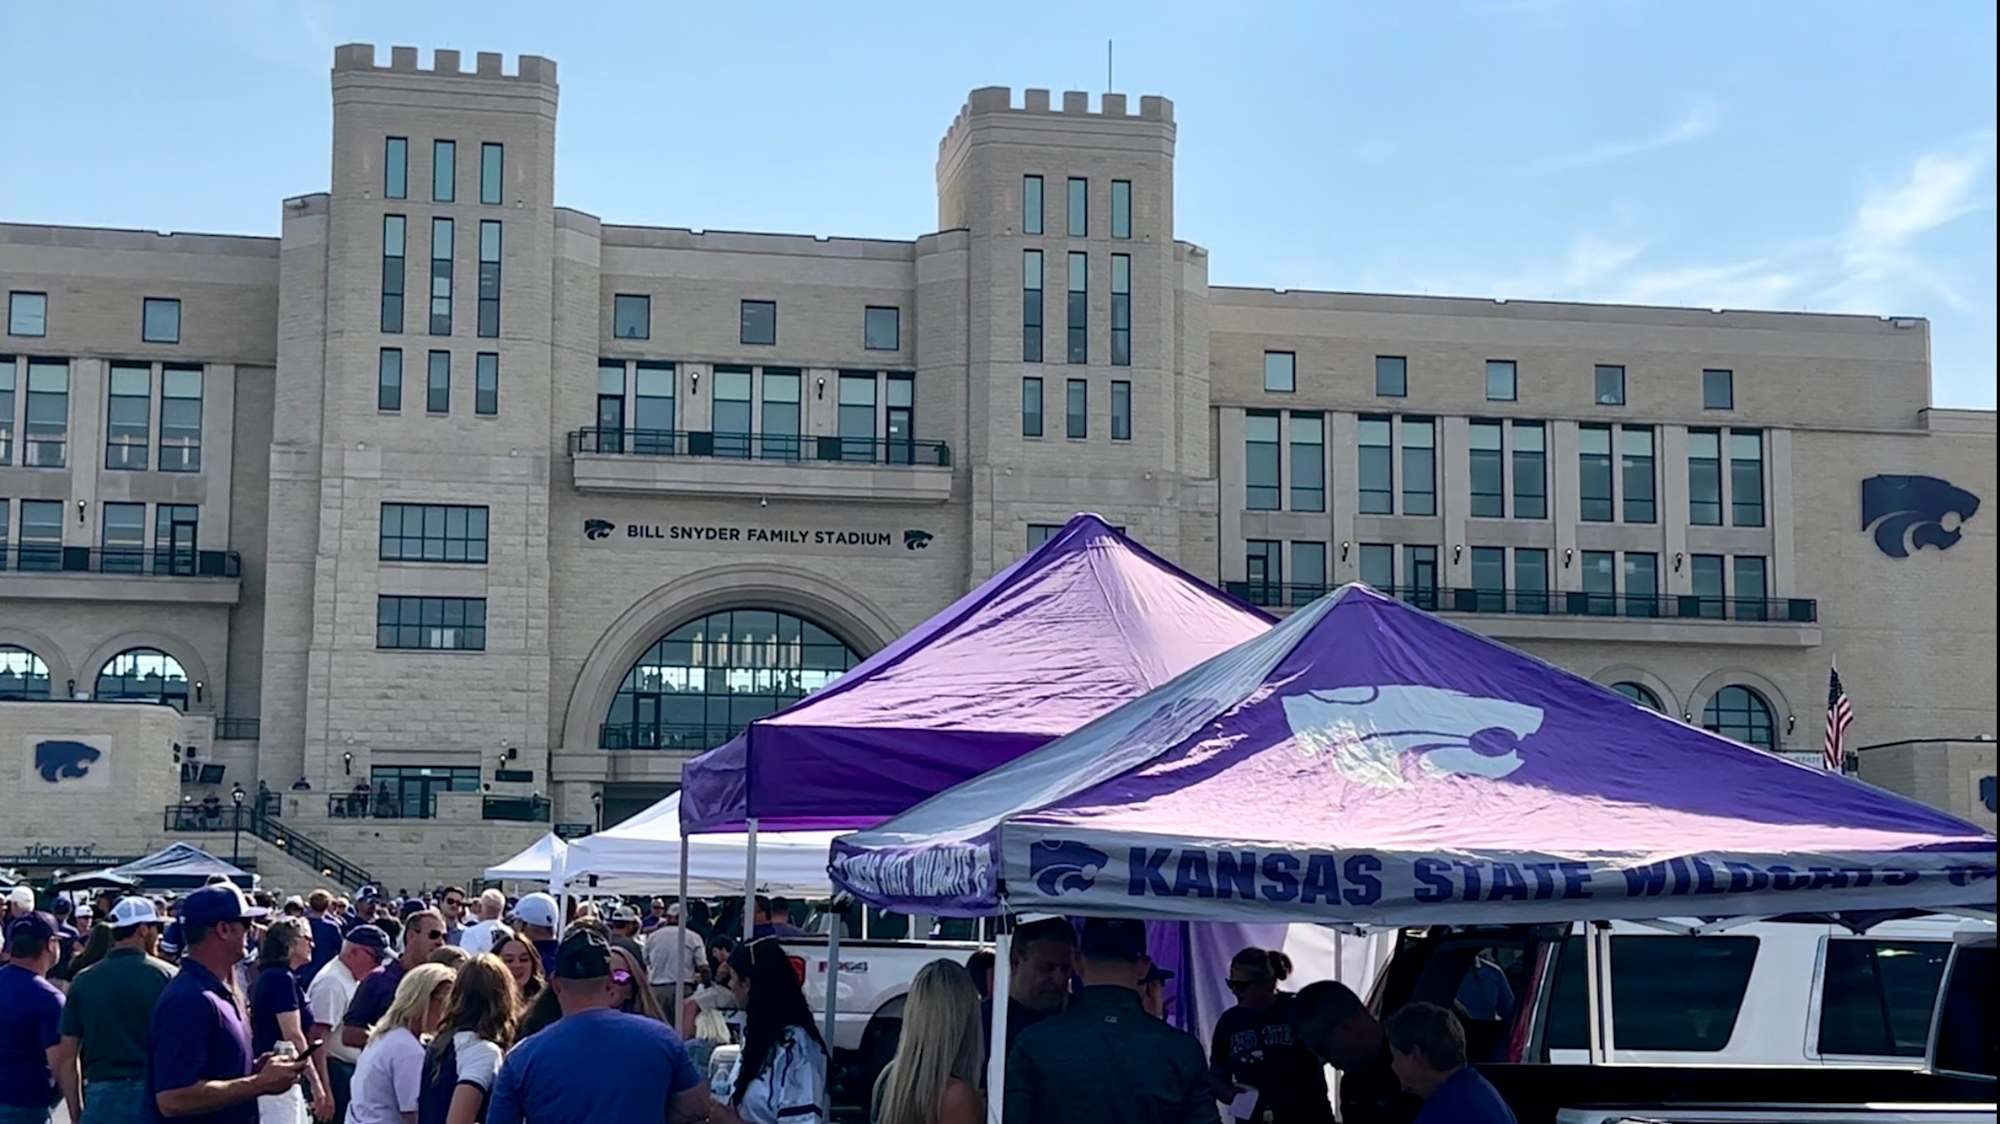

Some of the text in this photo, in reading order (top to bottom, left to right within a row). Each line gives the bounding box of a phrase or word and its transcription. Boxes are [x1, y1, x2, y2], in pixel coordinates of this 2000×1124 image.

[627, 524, 891, 546] BILL SNYDER FAMILY STADIUM
[24, 846, 93, 857] TICKETS
[1127, 847, 1383, 906] KANSAS
[1414, 857, 1594, 901] STATE
